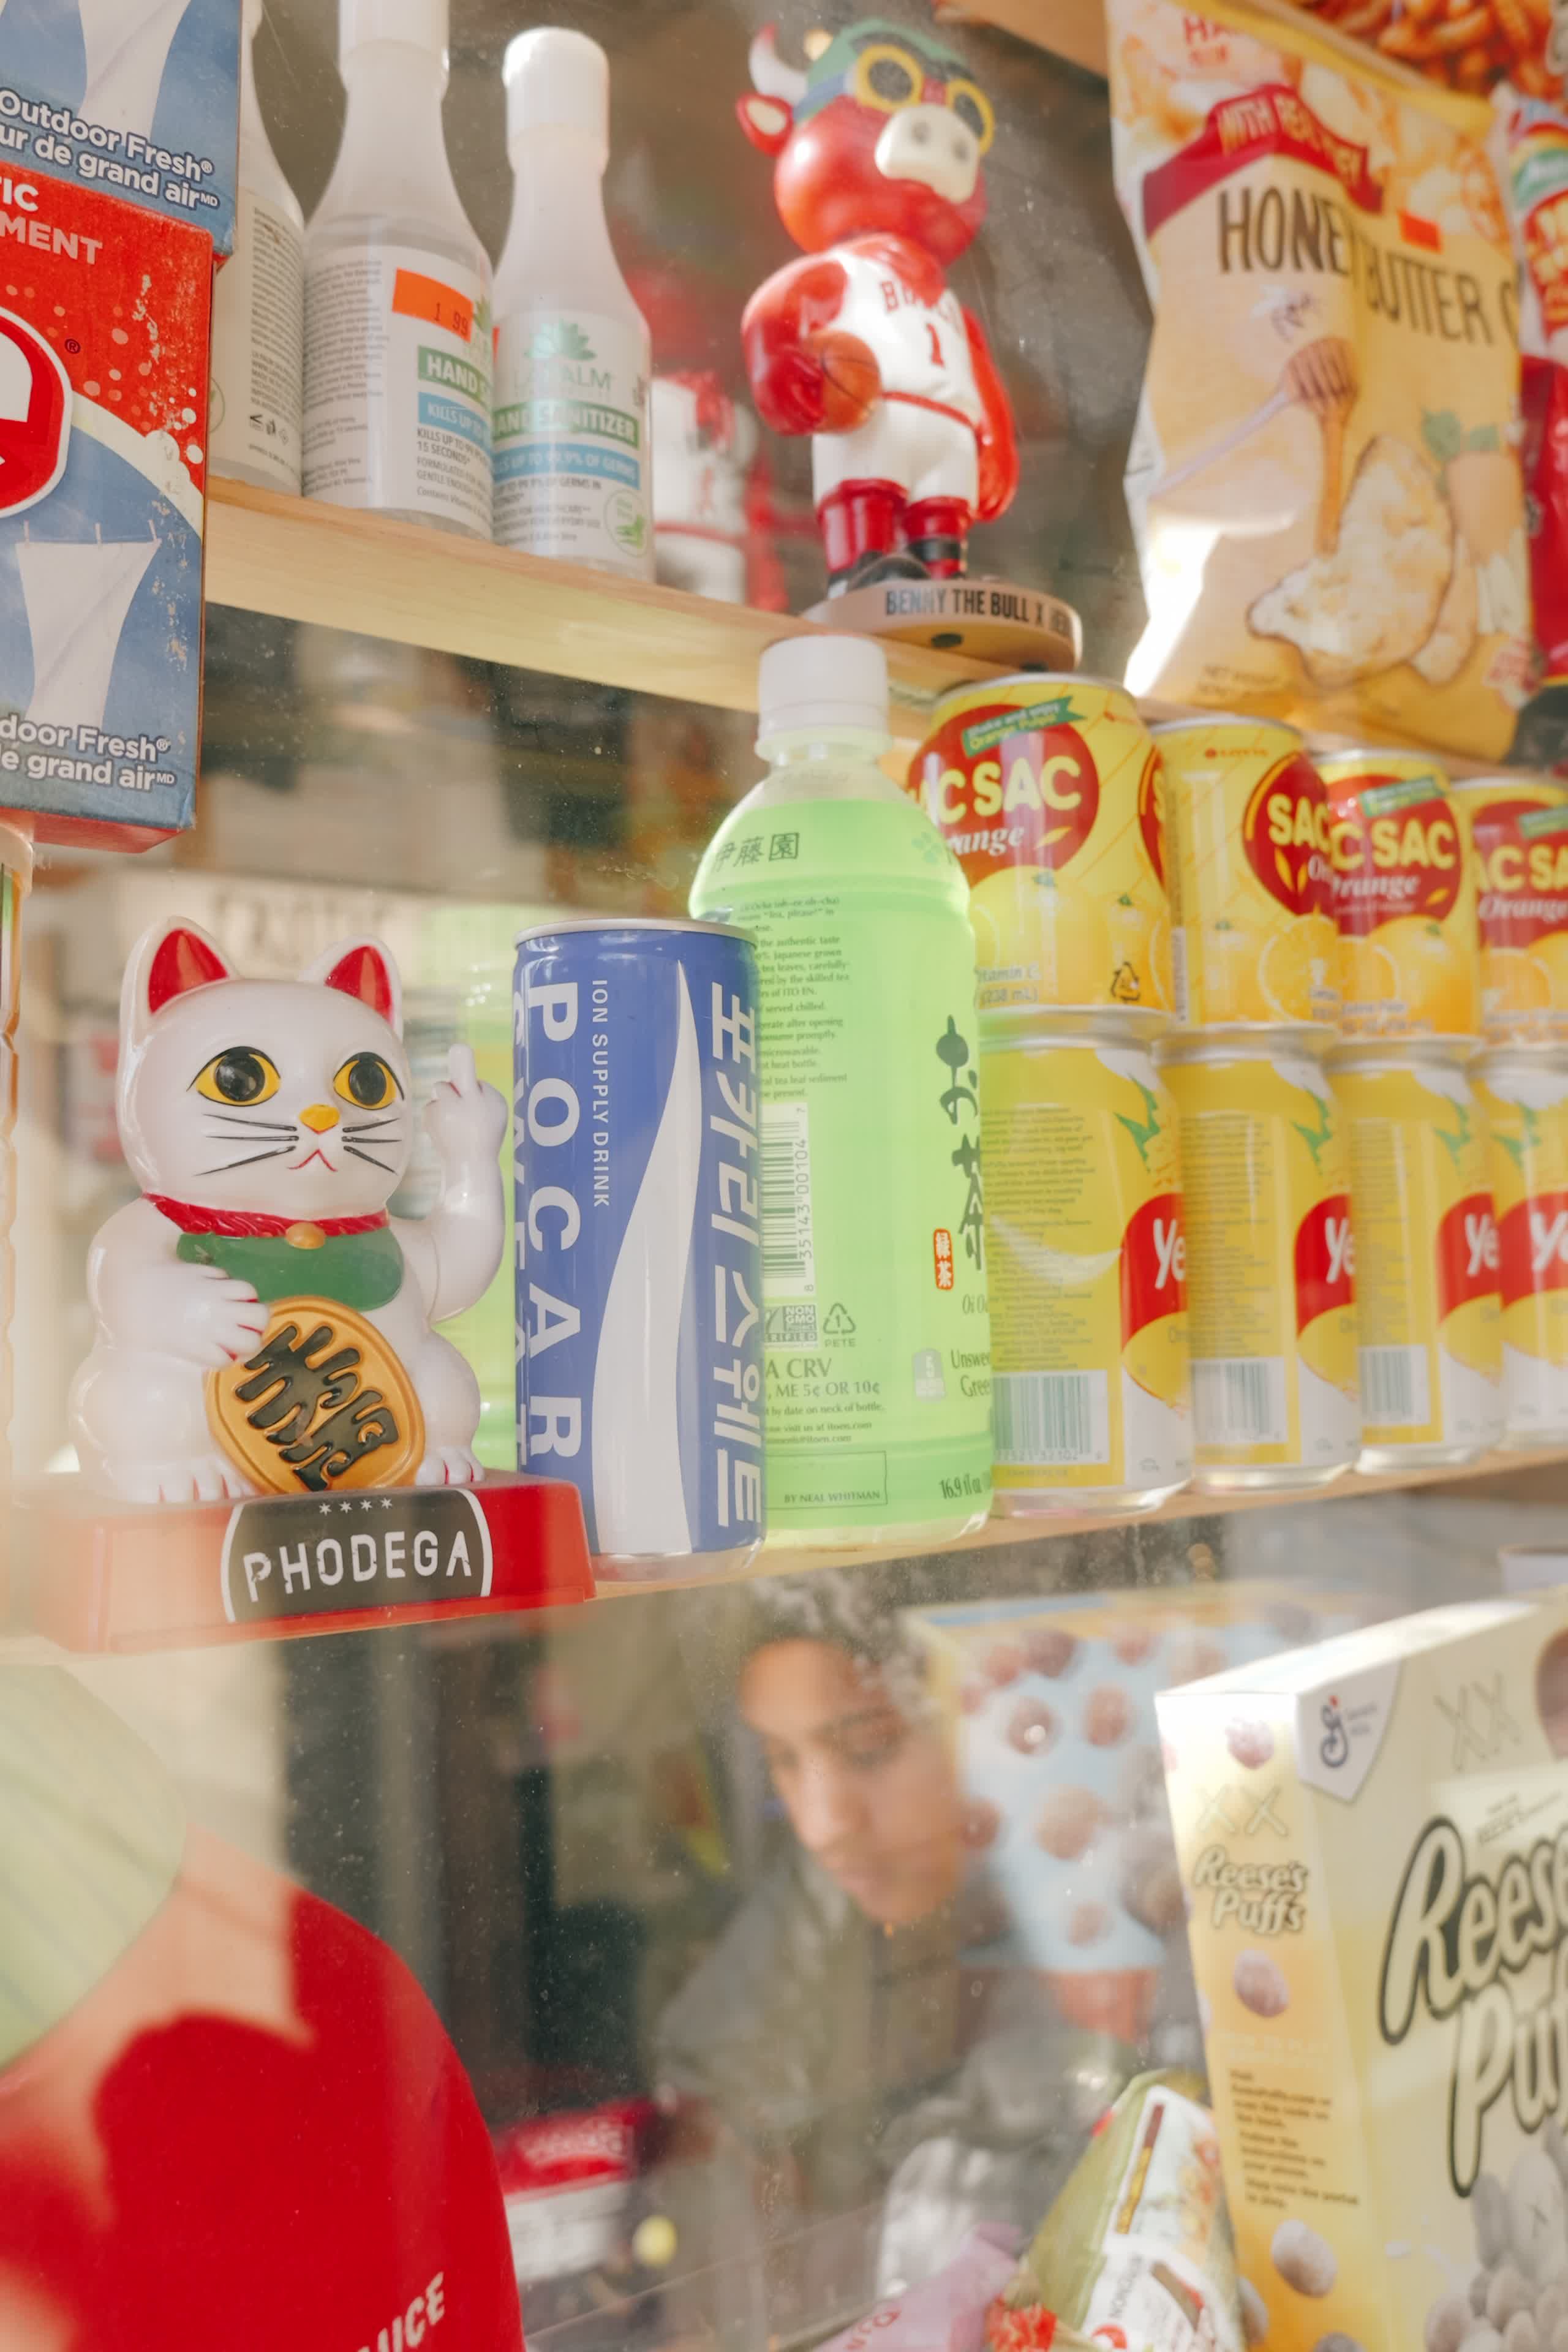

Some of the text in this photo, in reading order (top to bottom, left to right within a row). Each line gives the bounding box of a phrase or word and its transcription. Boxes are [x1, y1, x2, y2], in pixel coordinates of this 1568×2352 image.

[0, 88, 122, 151] Outdoor
[35, 135, 72, 167] de
[78, 151, 160, 196] grand
[0, 177, 39, 212] IC
[428, 352, 478, 393] HAND
[952, 588, 985, 614] THE
[990, 591, 1029, 623] BULL
[28, 755, 112, 785] grand
[972, 755, 1082, 818] SAC
[712, 832, 800, 872] 伊藤園
[1371, 818, 1456, 870] SAC
[592, 979, 609, 1208] ION SUPPLY DRINK
[795, 1139, 810, 1195] 00104
[527, 982, 582, 1457] POCAR
[797, 1204, 812, 1259] 35143
[785, 1305, 815, 1315] NON
[785, 1314, 815, 1324] GMO
[786, 1357, 832, 1379] CRV
[824, 1337, 857, 1348] PETE
[775, 1383, 799, 1398] ME
[825, 1381, 850, 1396] OR
[853, 1379, 881, 1396] 10¢
[784, 1404, 804, 1416] date
[821, 1403, 843, 1414] neck
[845, 1403, 854, 1413] of
[243, 1530, 472, 1602] PHODEGA
[1193, 1842, 1310, 1896] Reese's
[1208, 1885, 1307, 1937] Puffs
[357, 2271, 445, 2352] UCE
